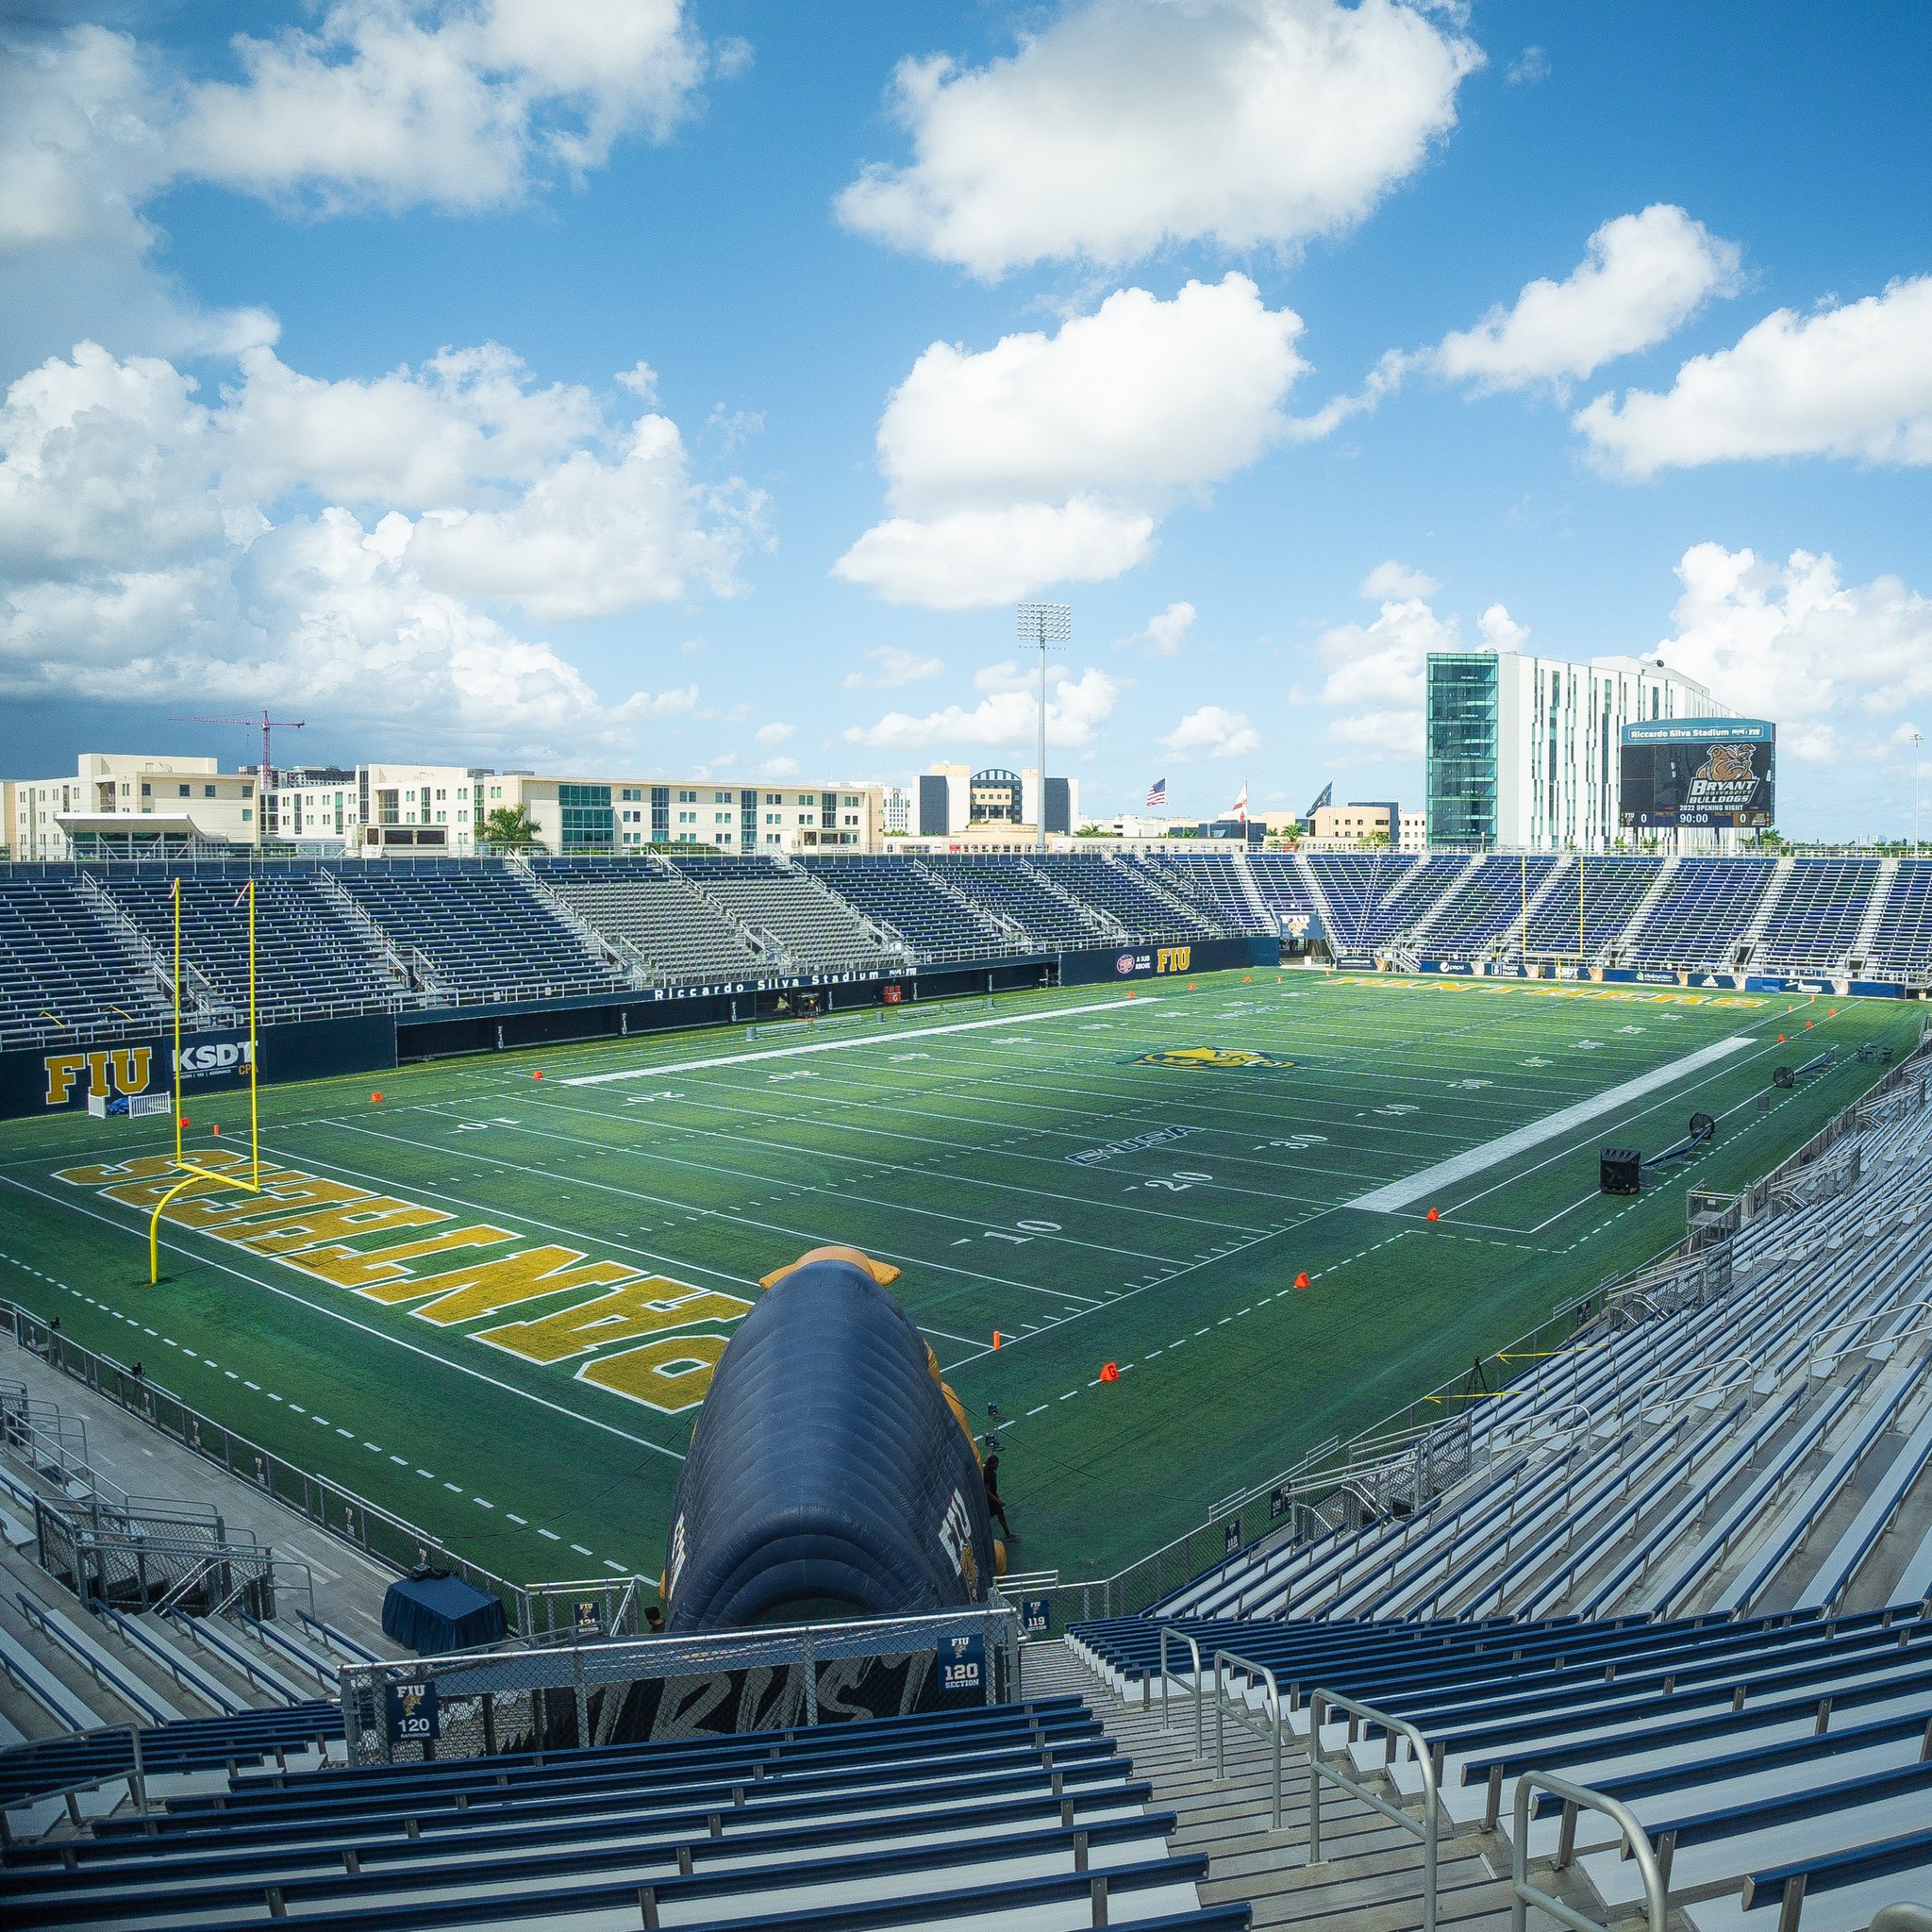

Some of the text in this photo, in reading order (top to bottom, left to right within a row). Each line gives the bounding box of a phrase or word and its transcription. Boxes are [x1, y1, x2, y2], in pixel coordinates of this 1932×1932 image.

[1630, 729, 1669, 739] Riccardo
[1692, 728, 1730, 737] Stadium
[1690, 780, 1757, 795] BRYANT
[1689, 794, 1750, 804] BULLDOGS
[1641, 813, 1648, 824] 0
[1679, 813, 1709, 824] 90:00
[1740, 813, 1746, 824] 0
[1158, 946, 1191, 973] FIU
[655, 981, 744, 1001] Riccardo
[758, 977, 800, 991] Silva
[811, 970, 879, 986] Stadium
[172, 1041, 258, 1073] KSDT
[44, 1046, 152, 1105] FIU
[1269, 1134, 1329, 1150] 30
[1144, 1172, 1214, 1192] 20
[982, 1220, 1062, 1245] 10
[50, 1149, 757, 1414] PANTHERS
[1108, 1365, 1117, 1378] G
[938, 1487, 972, 1576] FIU
[1028, 1616, 1045, 1627] 119
[951, 1637, 969, 1647] FIU
[944, 1662, 979, 1681] 120
[944, 1678, 979, 1689] SECTION
[396, 1685, 425, 1698] FIU
[397, 1717, 430, 1733] 120
[400, 1731, 431, 1740] BATHROOM
